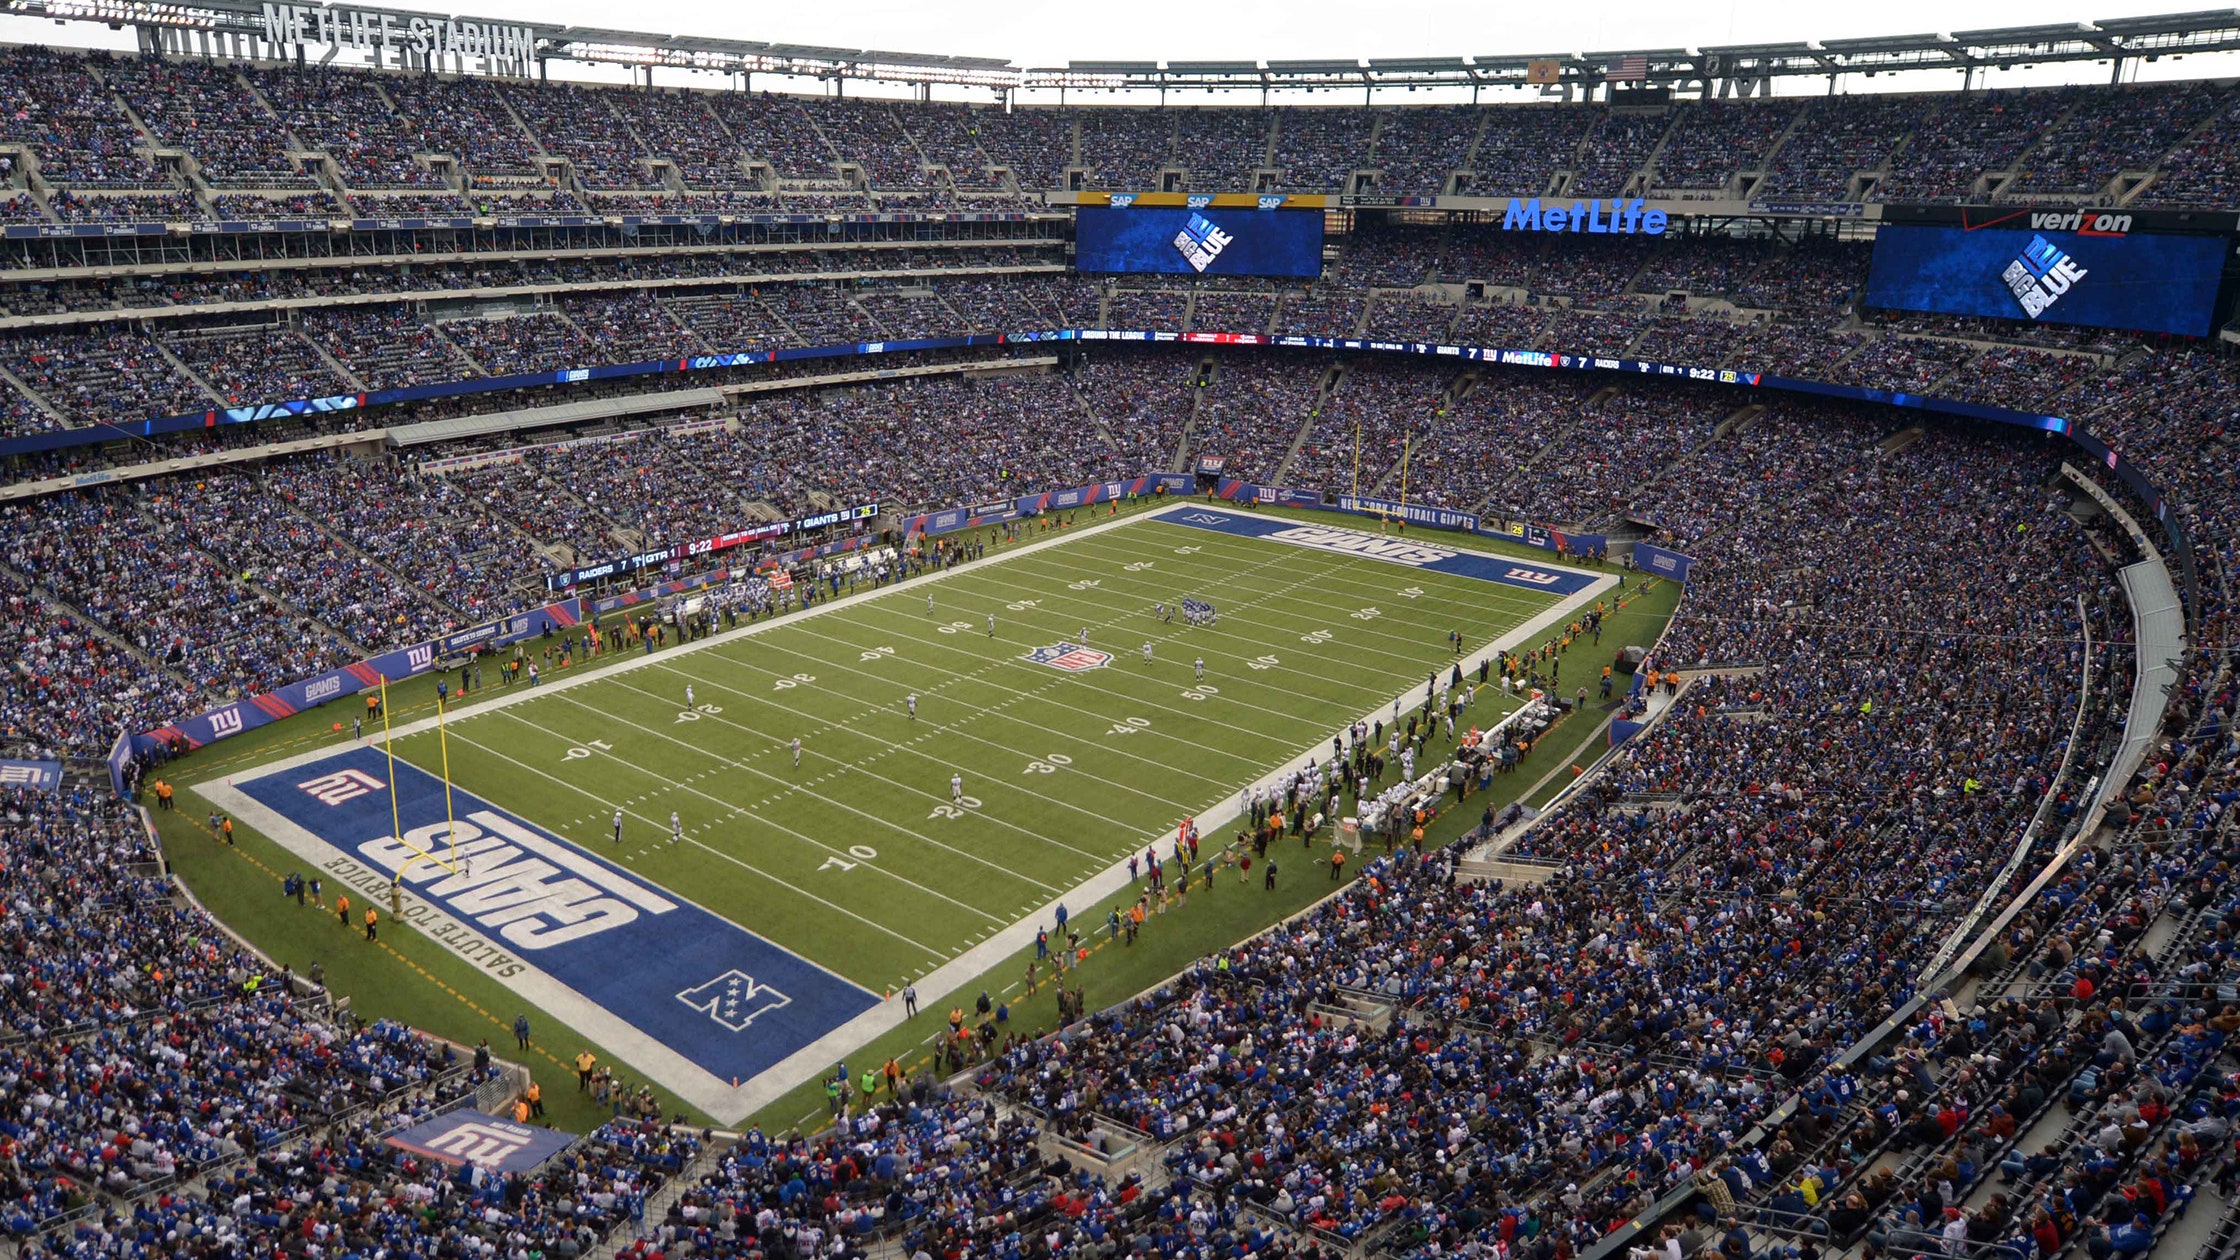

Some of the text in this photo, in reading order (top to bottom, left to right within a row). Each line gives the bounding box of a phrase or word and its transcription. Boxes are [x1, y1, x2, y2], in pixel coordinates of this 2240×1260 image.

[262, 3, 399, 51] METLIFE
[408, 17, 535, 62] STADIUM
[1110, 196, 1133, 207] SAP
[1187, 197, 1210, 208] SAP
[1258, 198, 1281, 209] SAP
[1502, 198, 1667, 234] MetLife
[2031, 209, 2133, 237] verizon
[1173, 231, 1198, 259] BIG
[1189, 226, 1234, 273] BLUE
[2002, 259, 2036, 299] BIG
[2019, 254, 2088, 319] BLUE
[1081, 331, 1145, 340] AROUND THE LEAGUE
[1436, 346, 1459, 355] GIANTS
[1468, 348, 1477, 359] 7
[1502, 351, 1552, 366] MetLife
[1578, 357, 1620, 369] 7 RAIDERS
[1689, 368, 1715, 380] 9:22
[803, 513, 838, 528] GIANTS
[860, 507, 871, 515] 25
[1340, 498, 1361, 511] NEW
[1392, 503, 1436, 523] FOOTBALL
[1512, 525, 1522, 535] 25
[645, 539, 712, 563] QTR 1 9:22
[1271, 526, 1458, 564] GIANTS
[578, 560, 627, 580] RAIDERS 7
[1123, 562, 1151, 571] 20
[1068, 579, 1098, 591] 30
[1397, 587, 1424, 599] 10
[1006, 599, 1036, 611] 40
[1350, 608, 1381, 621] 20
[451, 633, 469, 646] SALUTE
[476, 626, 495, 639] SERVICE
[937, 621, 974, 634] 50
[1300, 631, 1333, 644] 30
[407, 644, 432, 671] ny
[861, 646, 895, 660] 40
[1049, 650, 1106, 670] NFL
[1246, 656, 1279, 670] 40
[305, 675, 340, 699] GIANTS
[775, 673, 816, 690] 30
[1181, 685, 1219, 701] 50
[207, 707, 243, 737] ny
[678, 704, 723, 721] 20
[1113, 717, 1151, 734] 40
[567, 739, 613, 758] 10
[1028, 754, 1073, 774] 30
[934, 796, 982, 820] 20
[827, 845, 878, 872] 10
[357, 820, 639, 950] GIANTS
[403, 900, 440, 927] TO
[430, 922, 526, 978] SALUTE
[1887, 1109, 1901, 1128] 27
